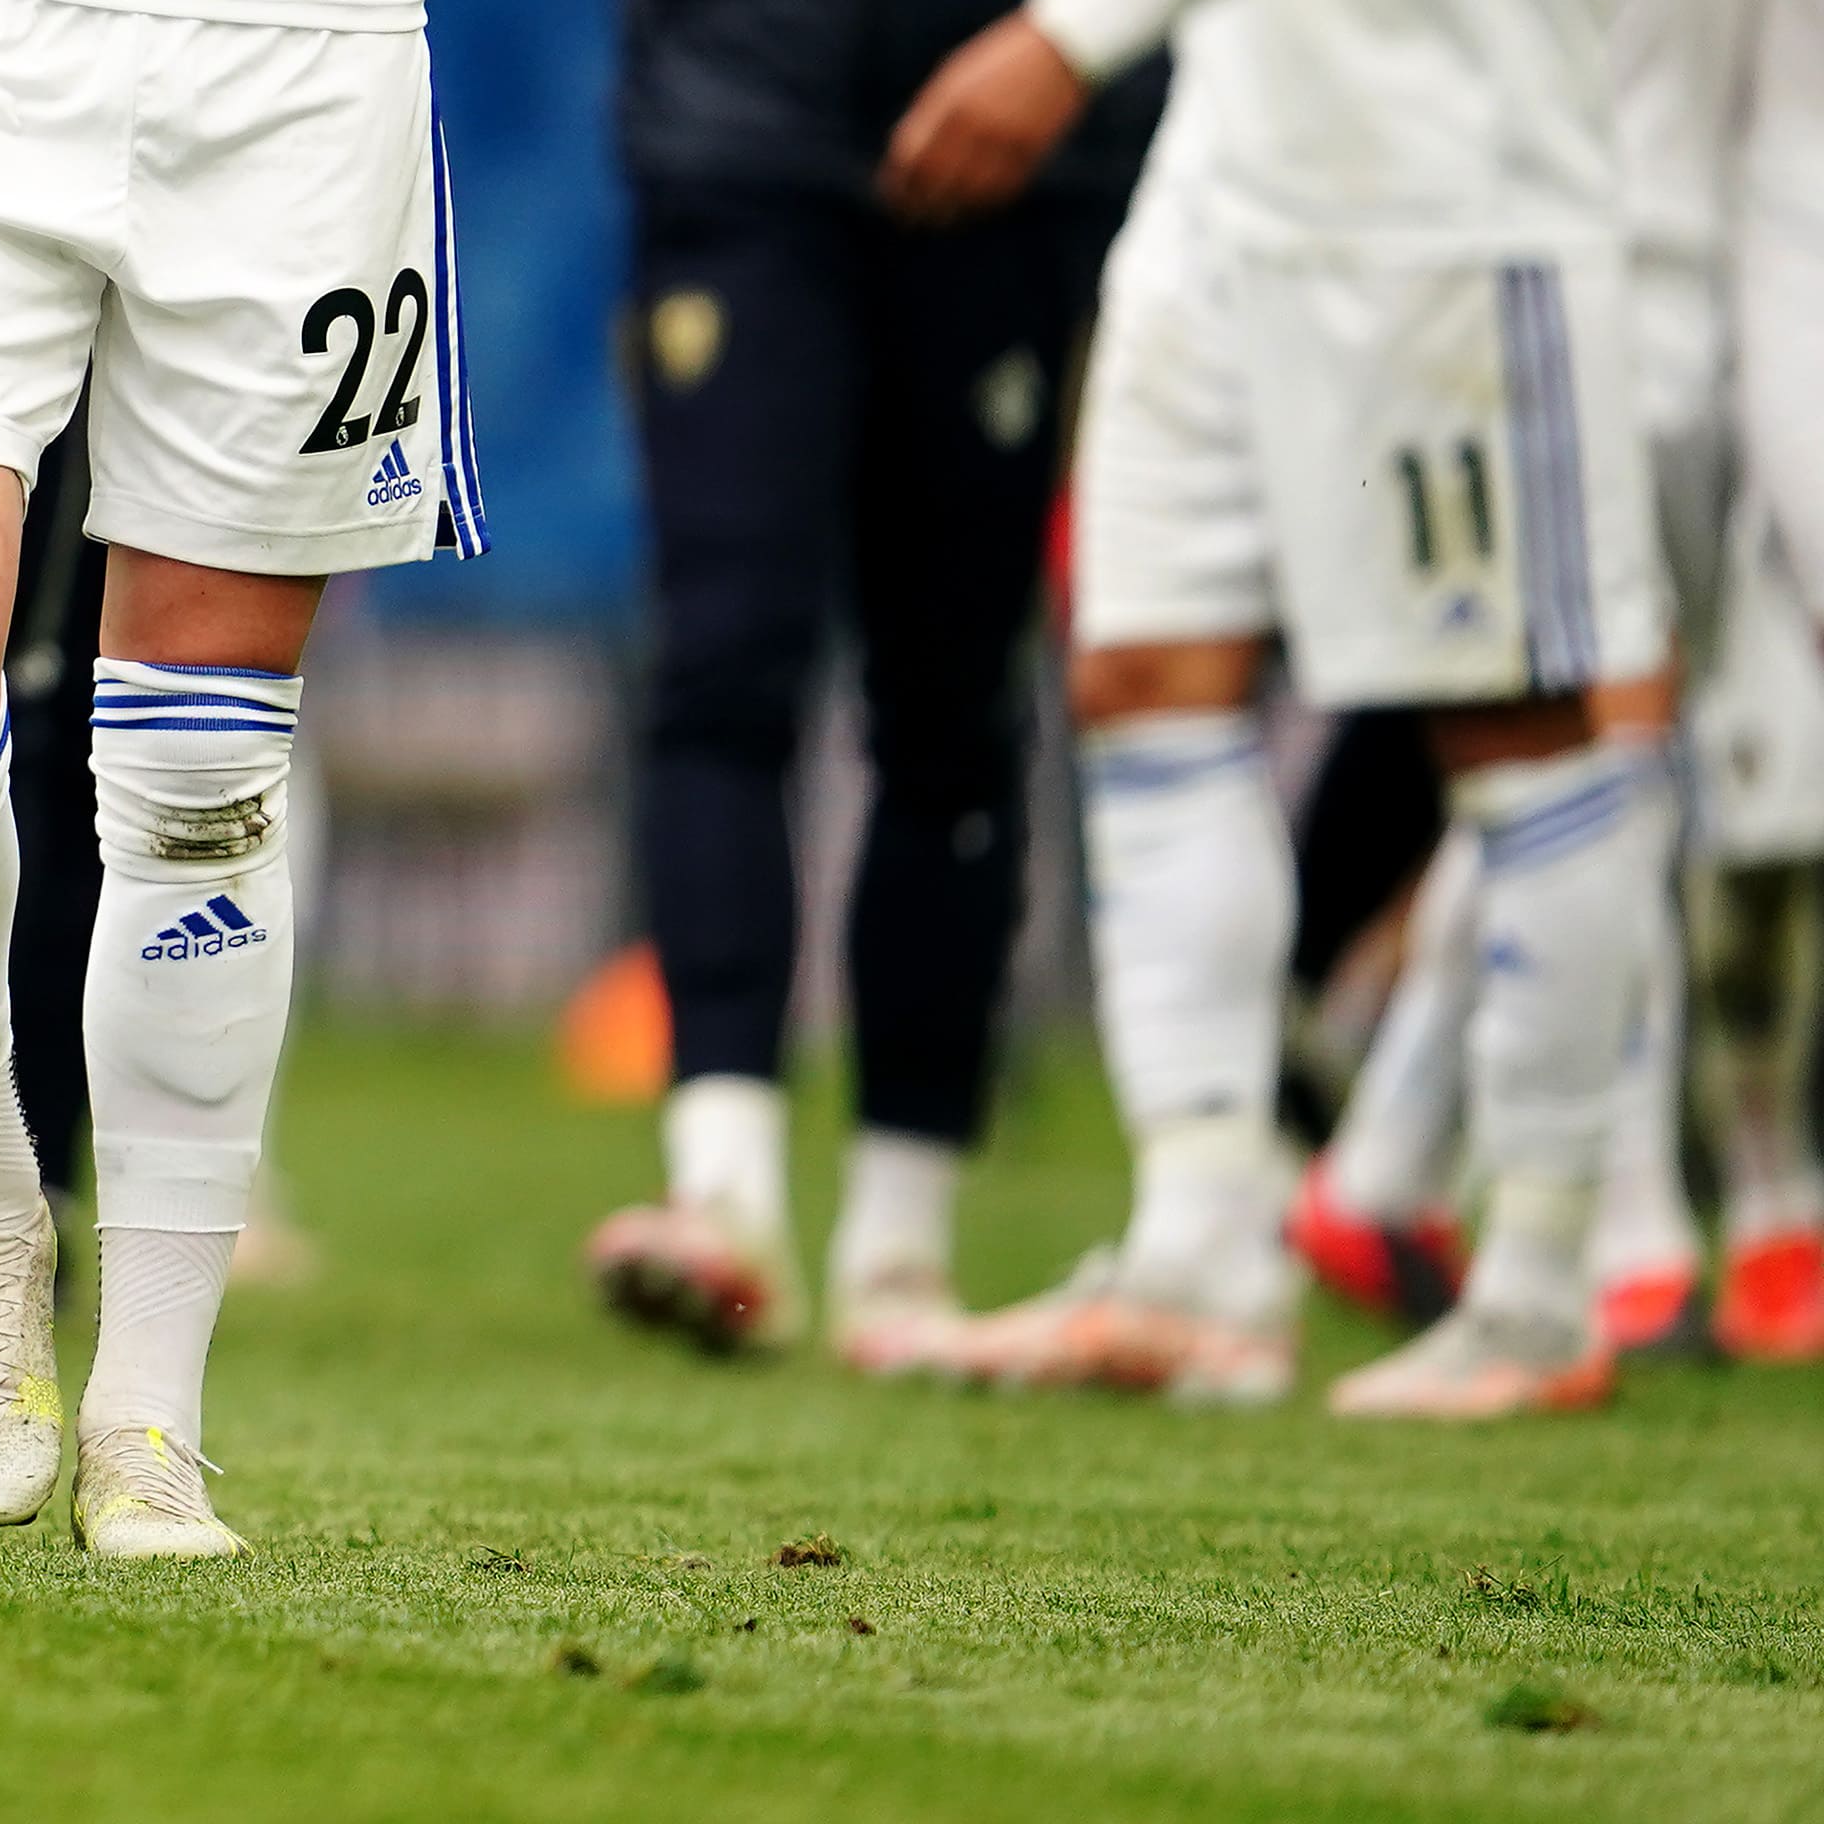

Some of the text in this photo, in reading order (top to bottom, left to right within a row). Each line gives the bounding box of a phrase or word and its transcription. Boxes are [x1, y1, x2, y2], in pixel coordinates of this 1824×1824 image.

[298, 267, 429, 455] 22
[367, 477, 423, 506] adidas
[1397, 434, 1494, 569] 11
[142, 928, 267, 960] adidas
